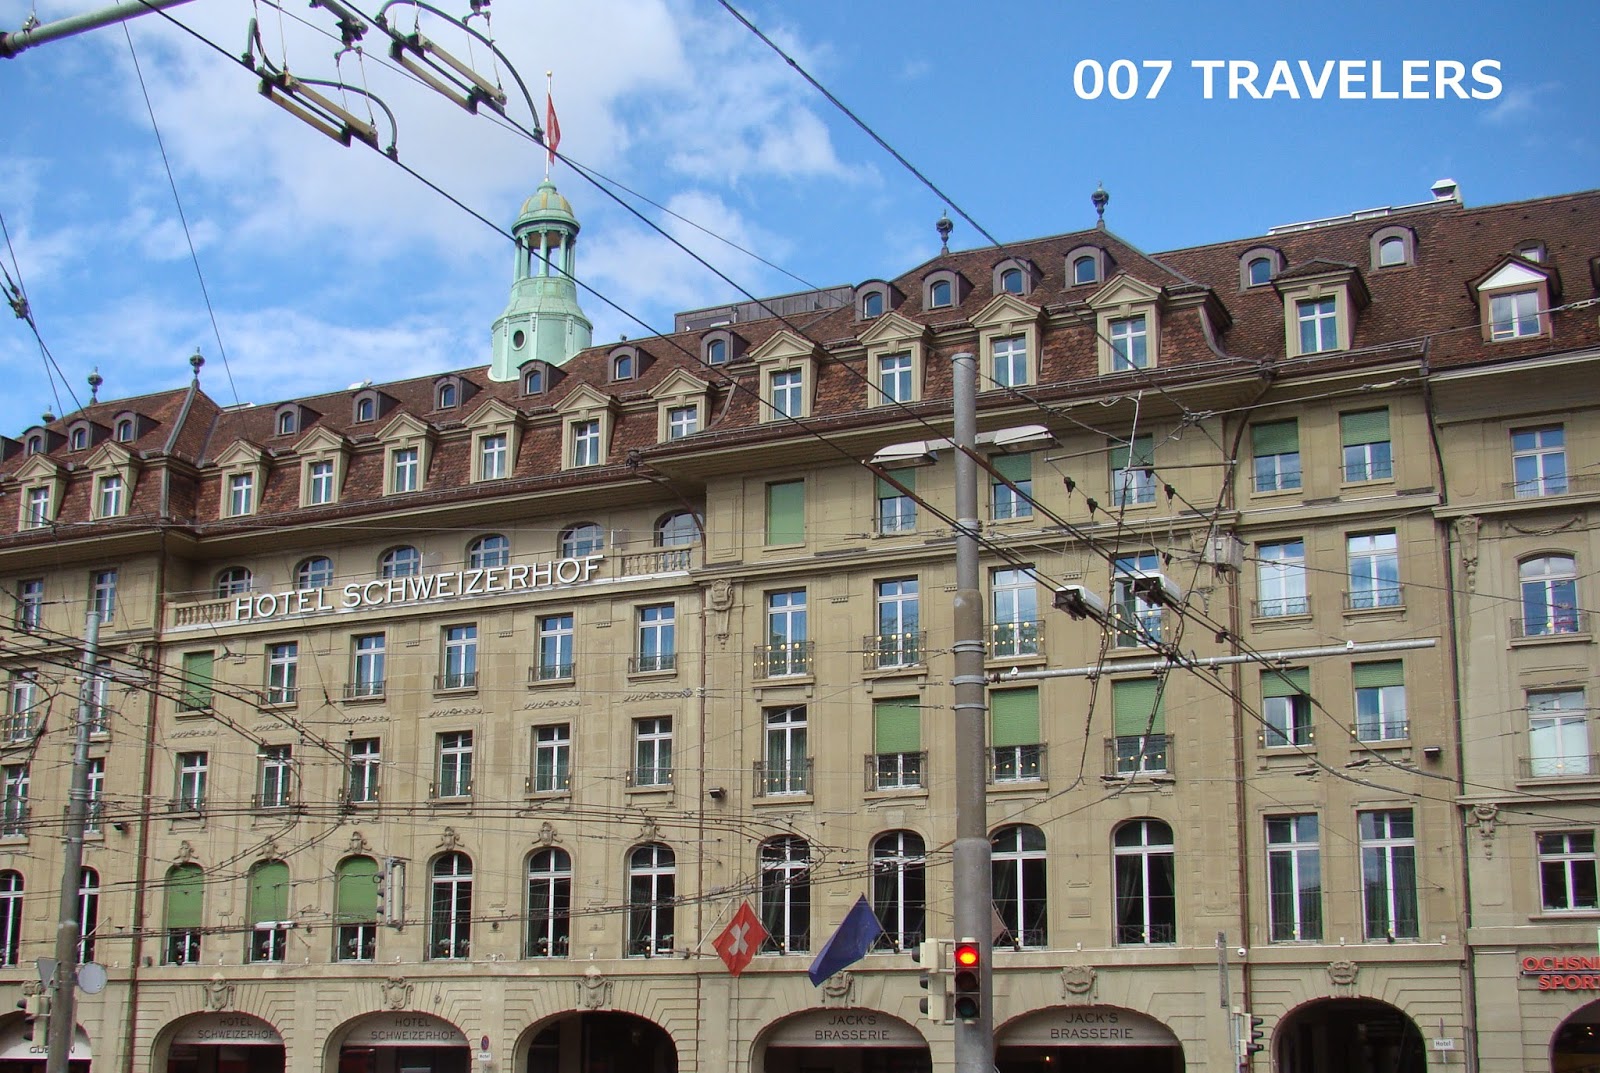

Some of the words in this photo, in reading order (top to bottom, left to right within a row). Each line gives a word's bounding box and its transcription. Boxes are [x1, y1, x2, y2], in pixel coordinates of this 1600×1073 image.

[235, 587, 333, 620] HOTEL
[342, 554, 604, 608] SCHWEIZERHOF
[220, 1018, 252, 1027] HOTEL
[395, 1018, 431, 1027] HOTEL
[828, 1015, 877, 1026] JACK'S
[1065, 1012, 1119, 1024] JACK'S
[198, 1029, 275, 1039] SCHWEIZERHOF
[371, 1030, 457, 1040] SCHWEIZERHOF
[814, 1030, 890, 1040] BRASSERIE
[1050, 1028, 1134, 1039] BRASSERIE
